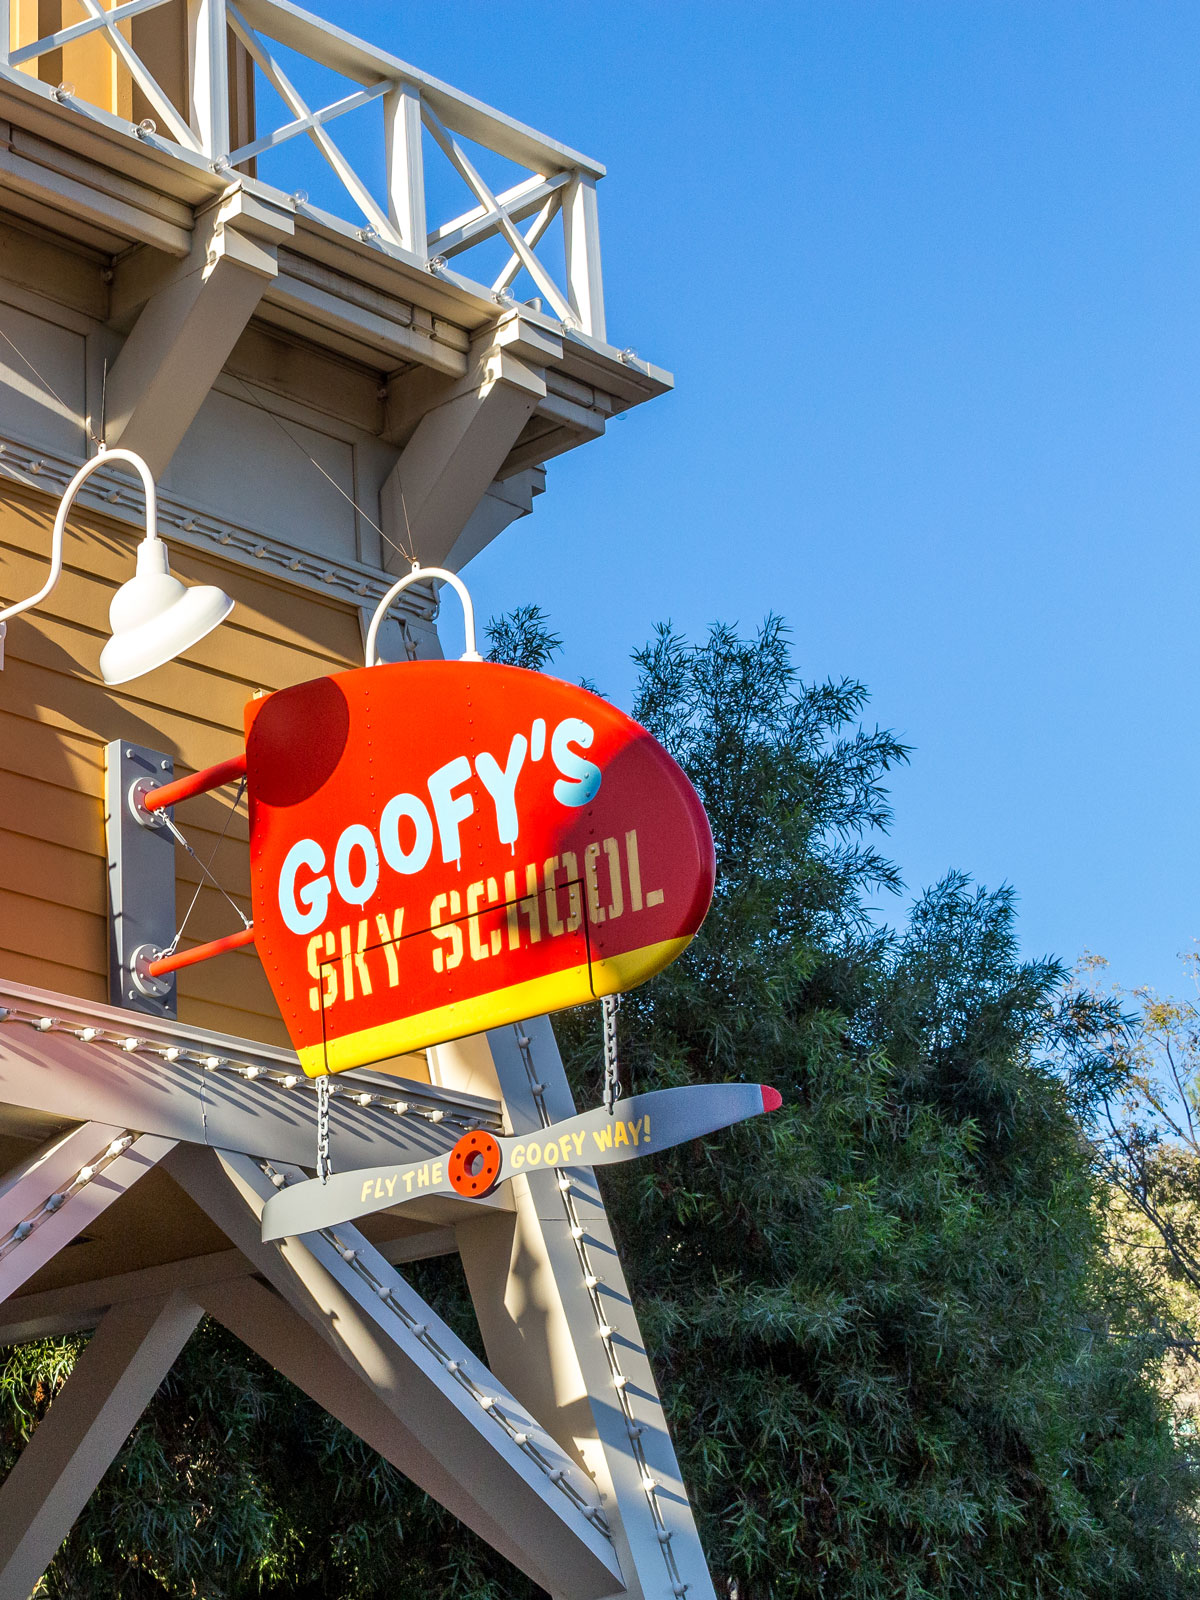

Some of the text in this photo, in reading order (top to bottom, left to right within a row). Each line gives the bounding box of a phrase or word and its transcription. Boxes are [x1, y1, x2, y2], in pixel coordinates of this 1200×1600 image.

[278, 717, 602, 935] GOOFY'S
[306, 829, 665, 1012] SKY SCHOOL
[360, 1114, 652, 1203] FLY THE GOOFY WAY!
